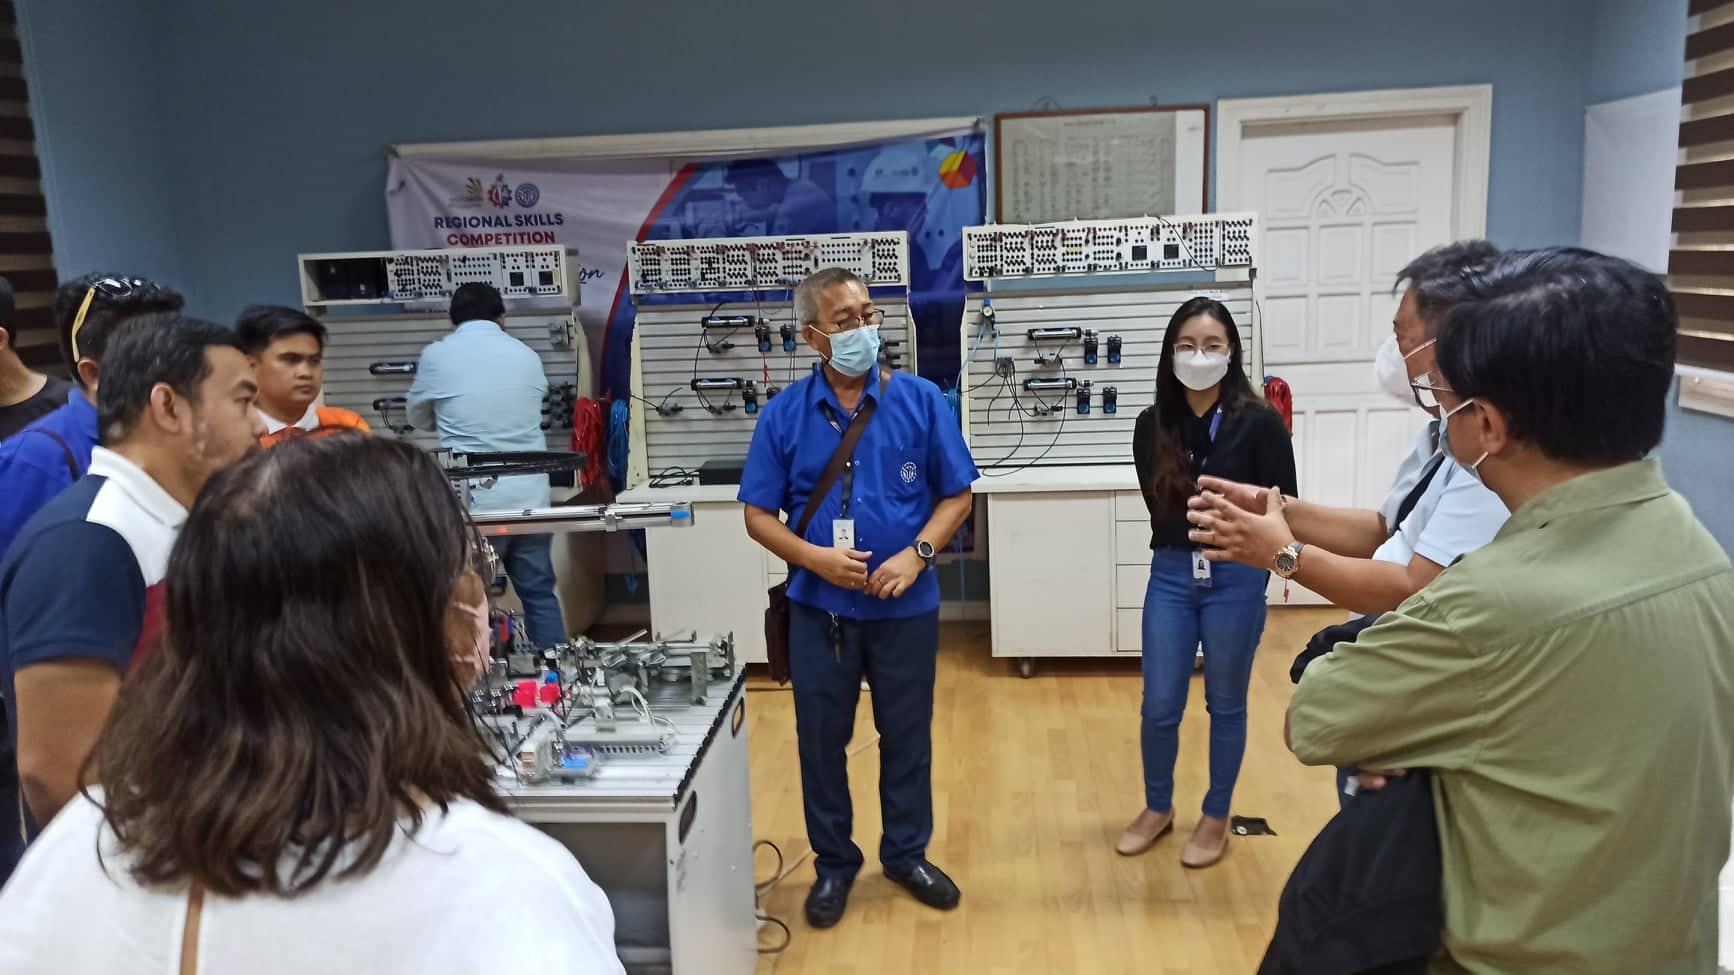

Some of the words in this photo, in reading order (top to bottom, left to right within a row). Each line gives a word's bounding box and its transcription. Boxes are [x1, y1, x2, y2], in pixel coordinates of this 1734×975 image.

[434, 214, 513, 229] REGIONAL
[514, 213, 564, 227] SKILLS
[447, 231, 556, 246] COMPETITION
